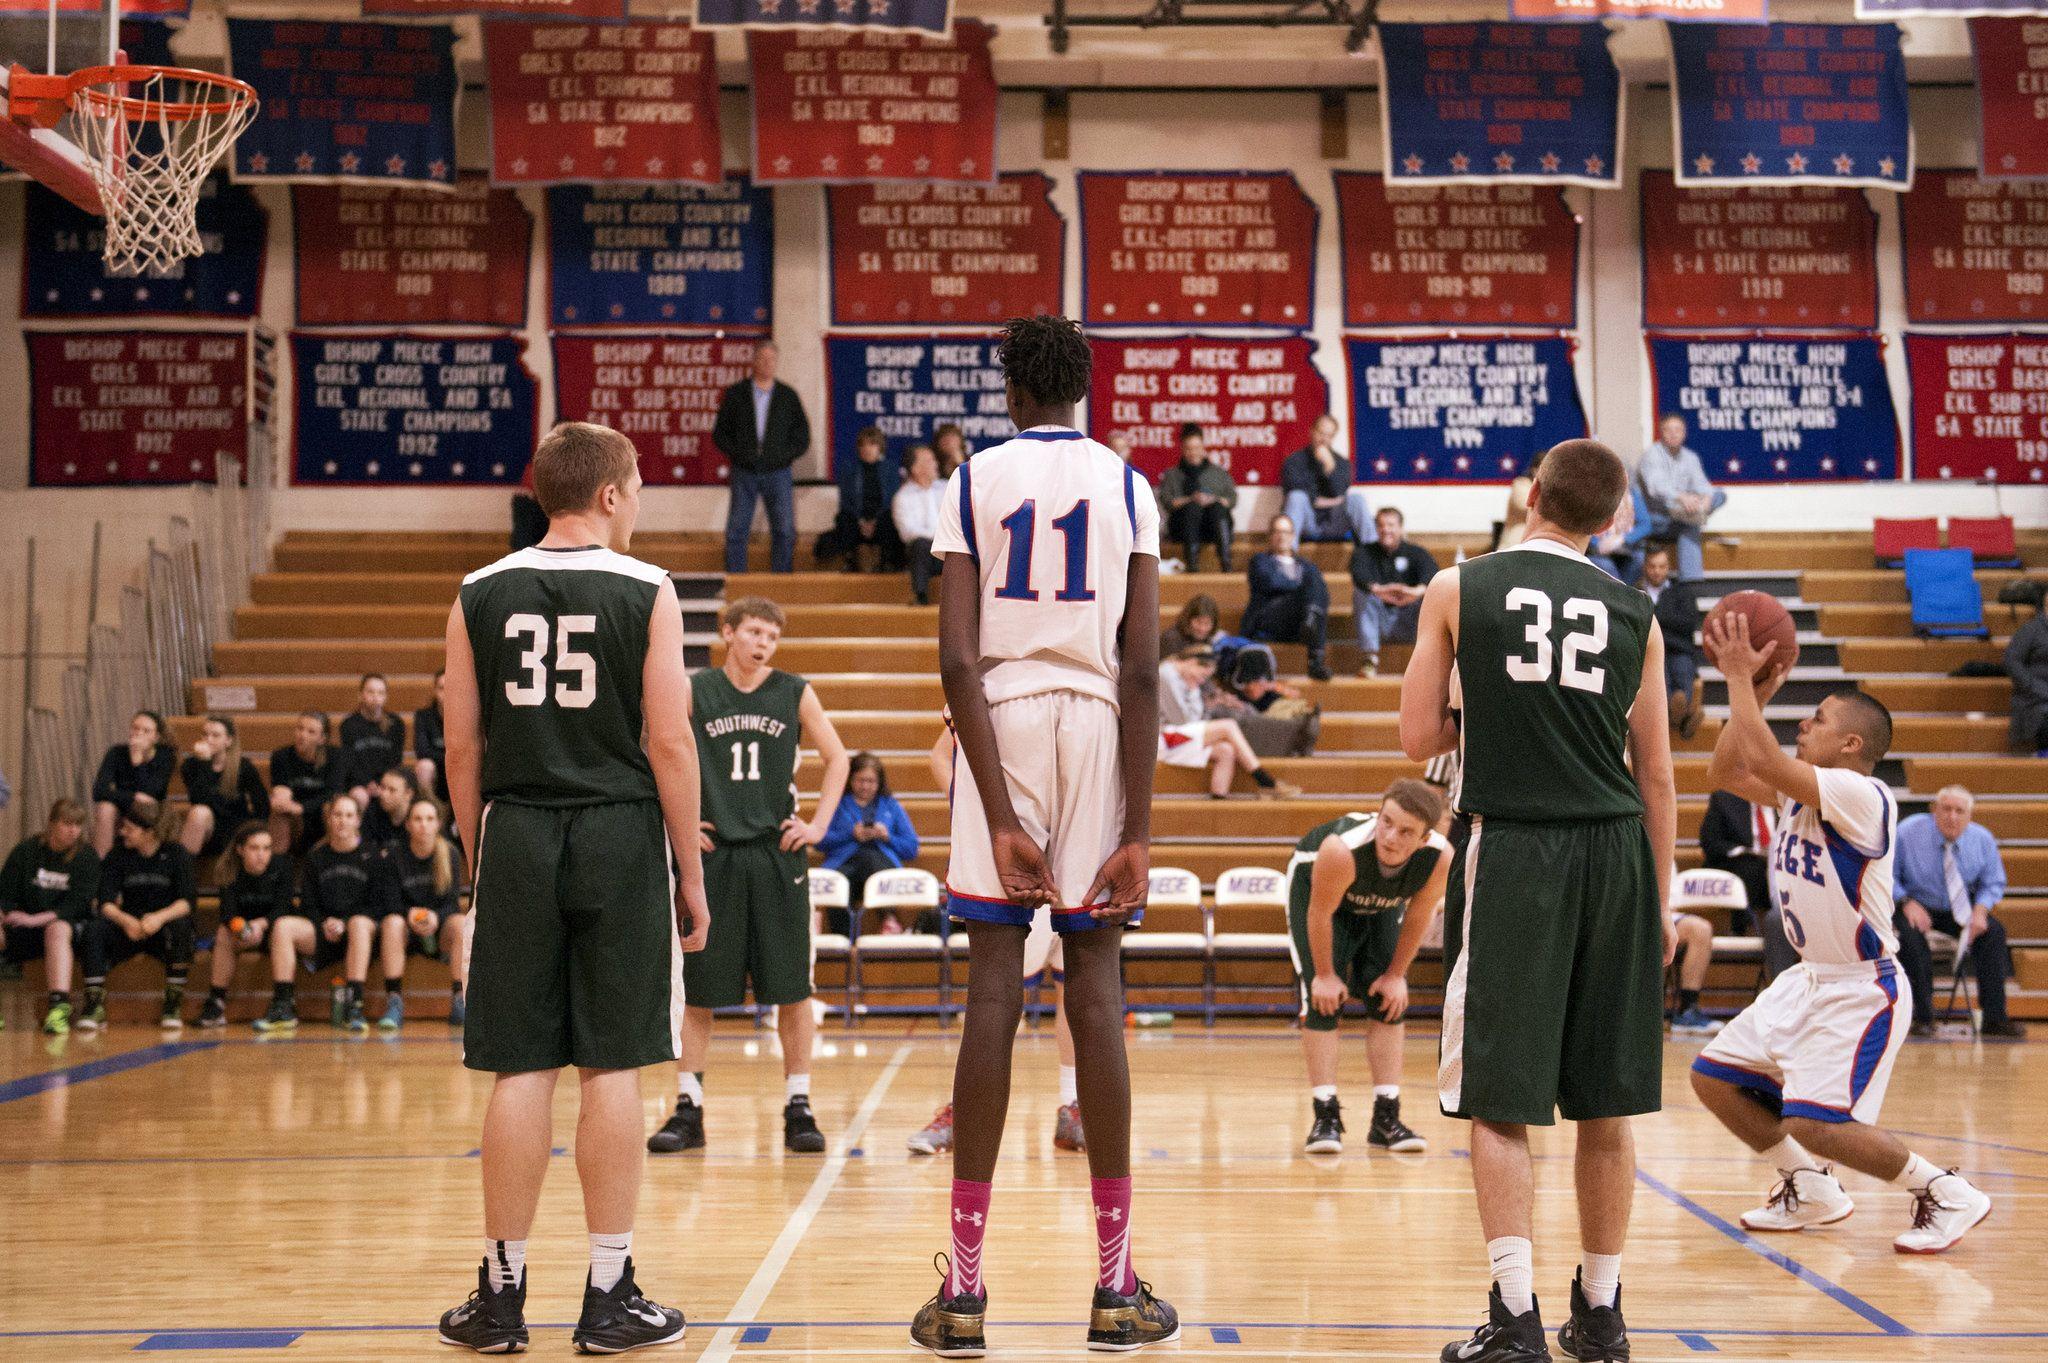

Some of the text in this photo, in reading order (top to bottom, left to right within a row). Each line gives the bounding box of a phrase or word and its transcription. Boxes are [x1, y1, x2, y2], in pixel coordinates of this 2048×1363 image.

[185, 385, 219, 408] AND
[444, 387, 479, 409] AND
[79, 409, 125, 431] STATE
[340, 410, 388, 432] STATE
[1698, 407, 1745, 430] STATE
[1972, 414, 2024, 438] STATE
[995, 499, 1096, 601] 11
[1506, 587, 1608, 694] 32
[504, 613, 597, 708] 35
[705, 714, 786, 738] SOUTHWEST
[731, 741, 760, 780] 11
